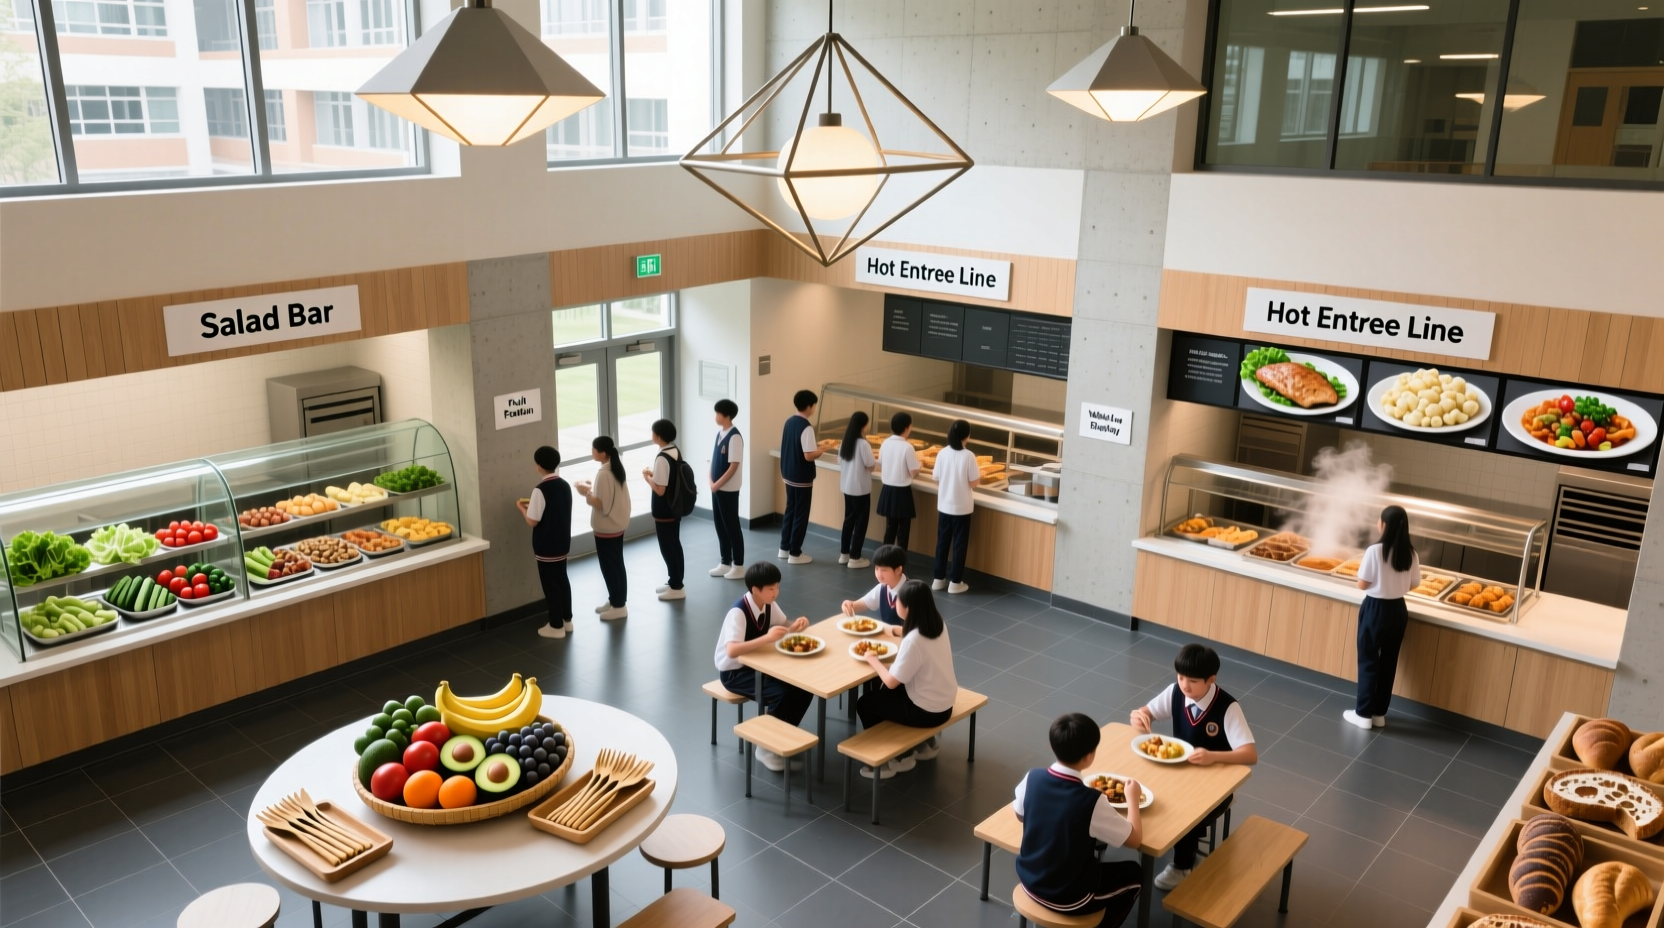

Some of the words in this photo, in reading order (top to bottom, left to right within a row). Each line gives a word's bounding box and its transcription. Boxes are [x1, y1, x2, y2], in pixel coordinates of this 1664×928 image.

[867, 257, 895, 276] Hot
[900, 260, 955, 283] Entree
[959, 266, 997, 288] Line
[200, 304, 280, 339] Salad
[287, 302, 334, 328] Bar
[1267, 300, 1310, 326] Hot
[1316, 306, 1401, 336] Entree
[1407, 315, 1464, 344] Line
